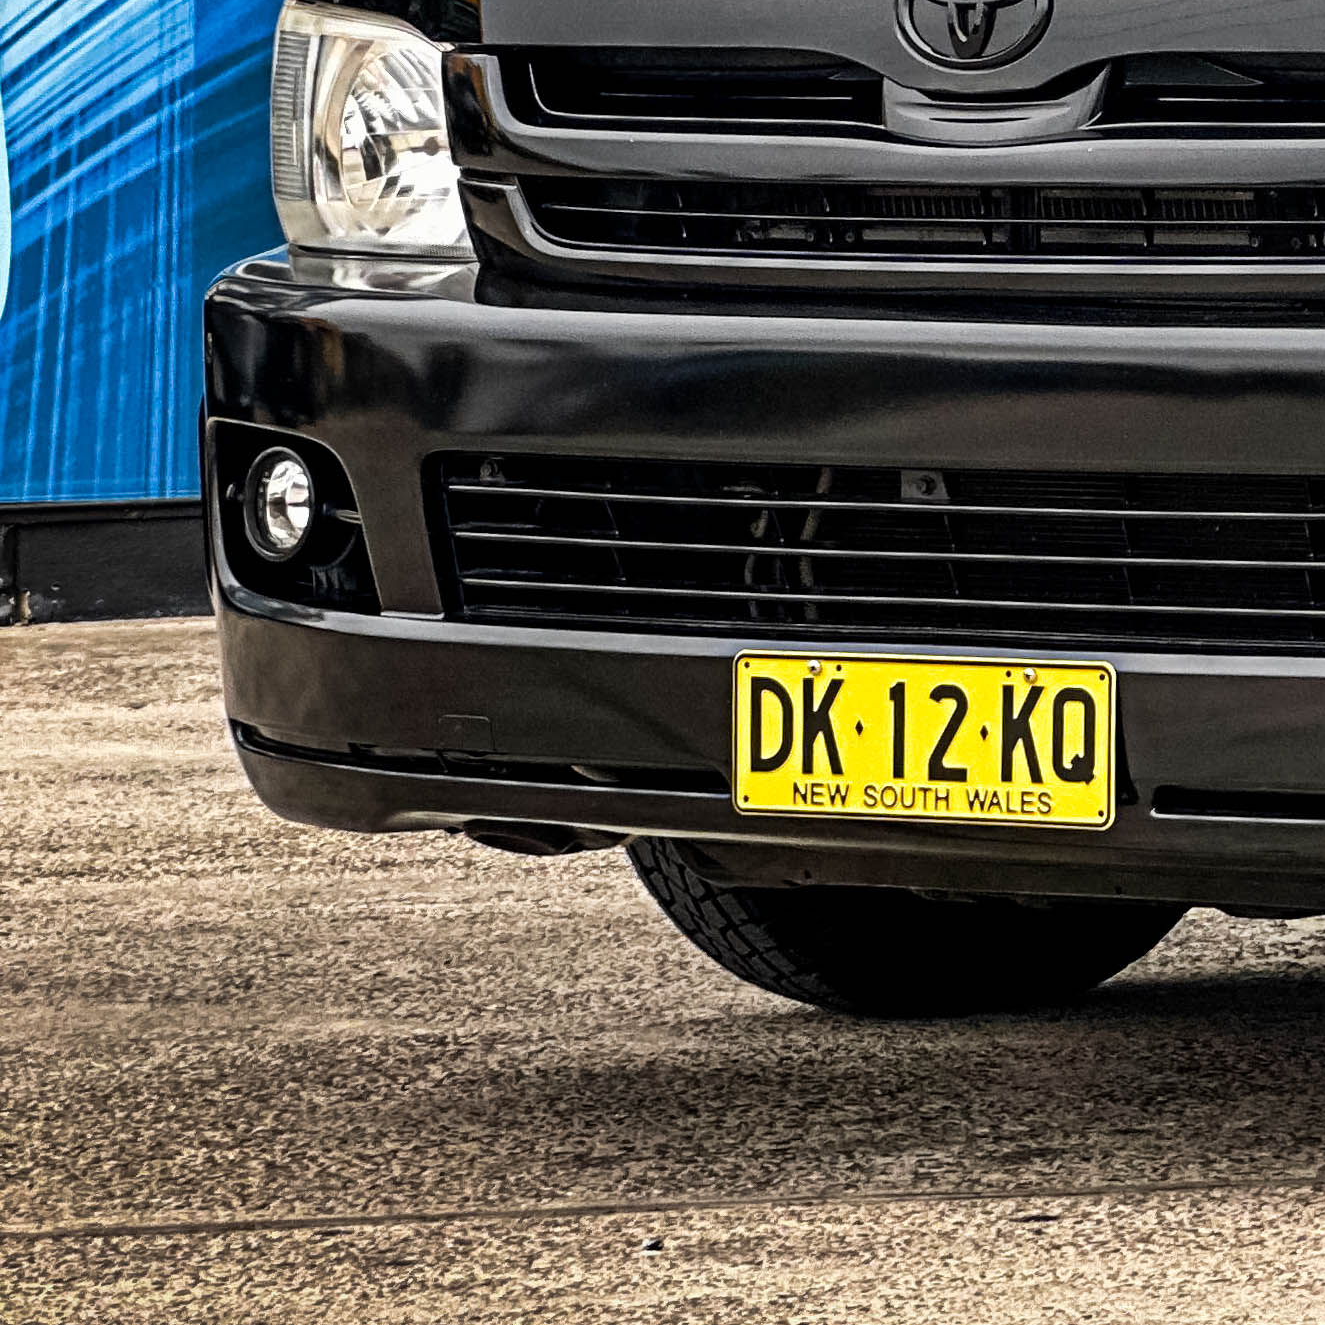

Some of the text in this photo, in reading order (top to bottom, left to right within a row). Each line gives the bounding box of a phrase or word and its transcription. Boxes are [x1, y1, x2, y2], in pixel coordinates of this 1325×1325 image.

[792, 781, 1053, 815] NEW SOUTH WALES
